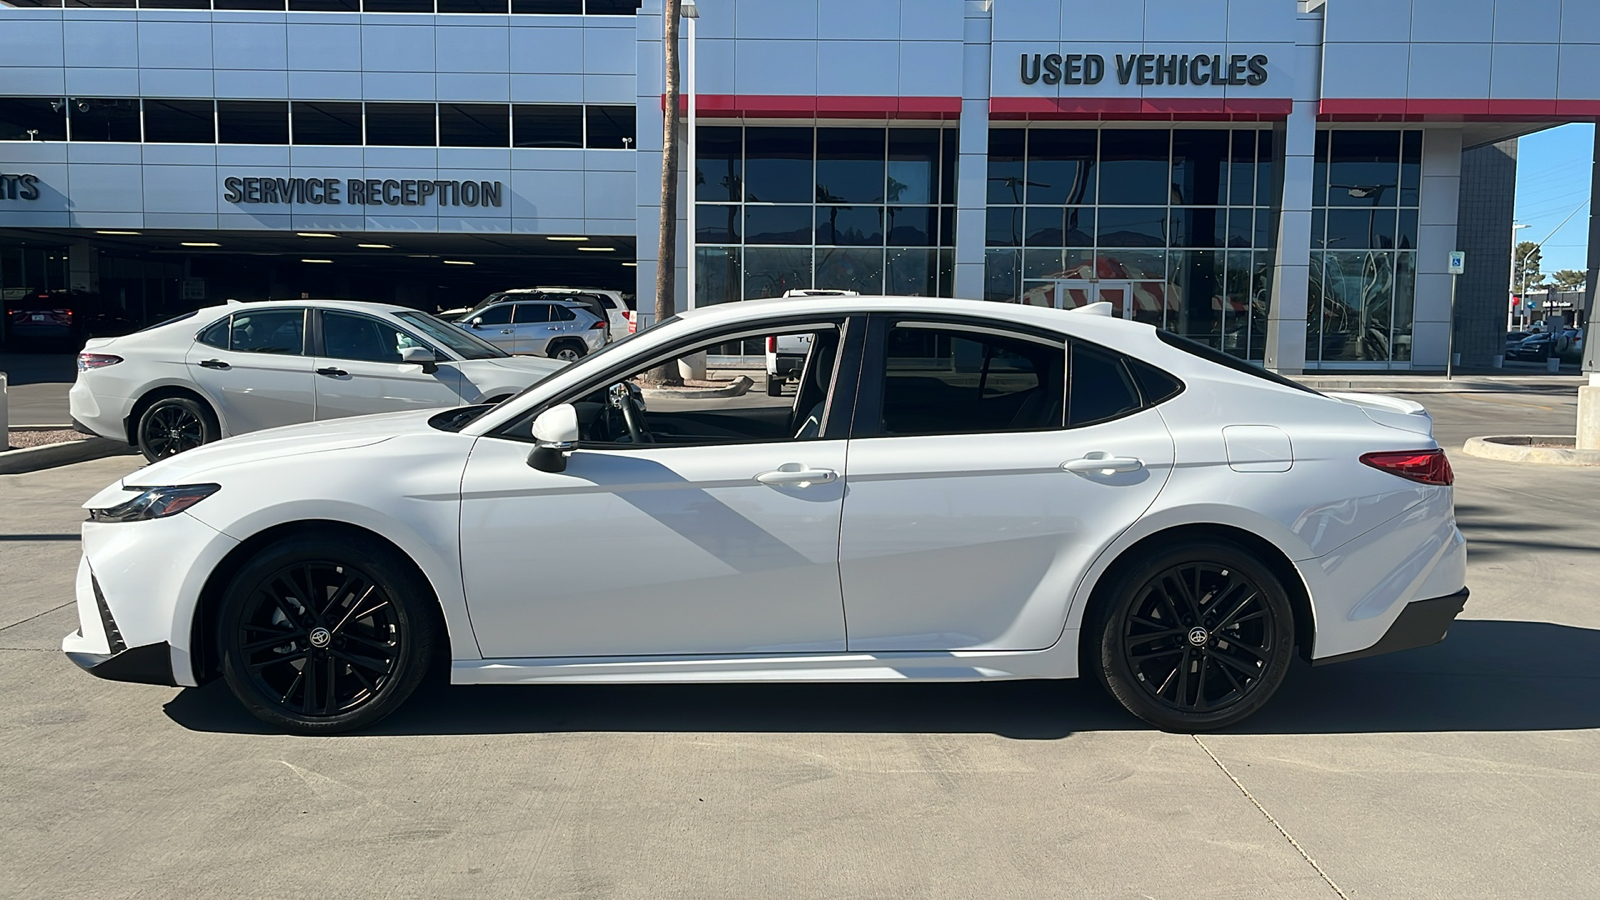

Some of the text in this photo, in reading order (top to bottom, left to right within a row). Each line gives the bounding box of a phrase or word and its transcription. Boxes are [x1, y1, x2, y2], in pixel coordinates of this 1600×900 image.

[1020, 53, 1268, 86] USED VEHICLES
[224, 176, 502, 207] SERVICE RECEPTION
